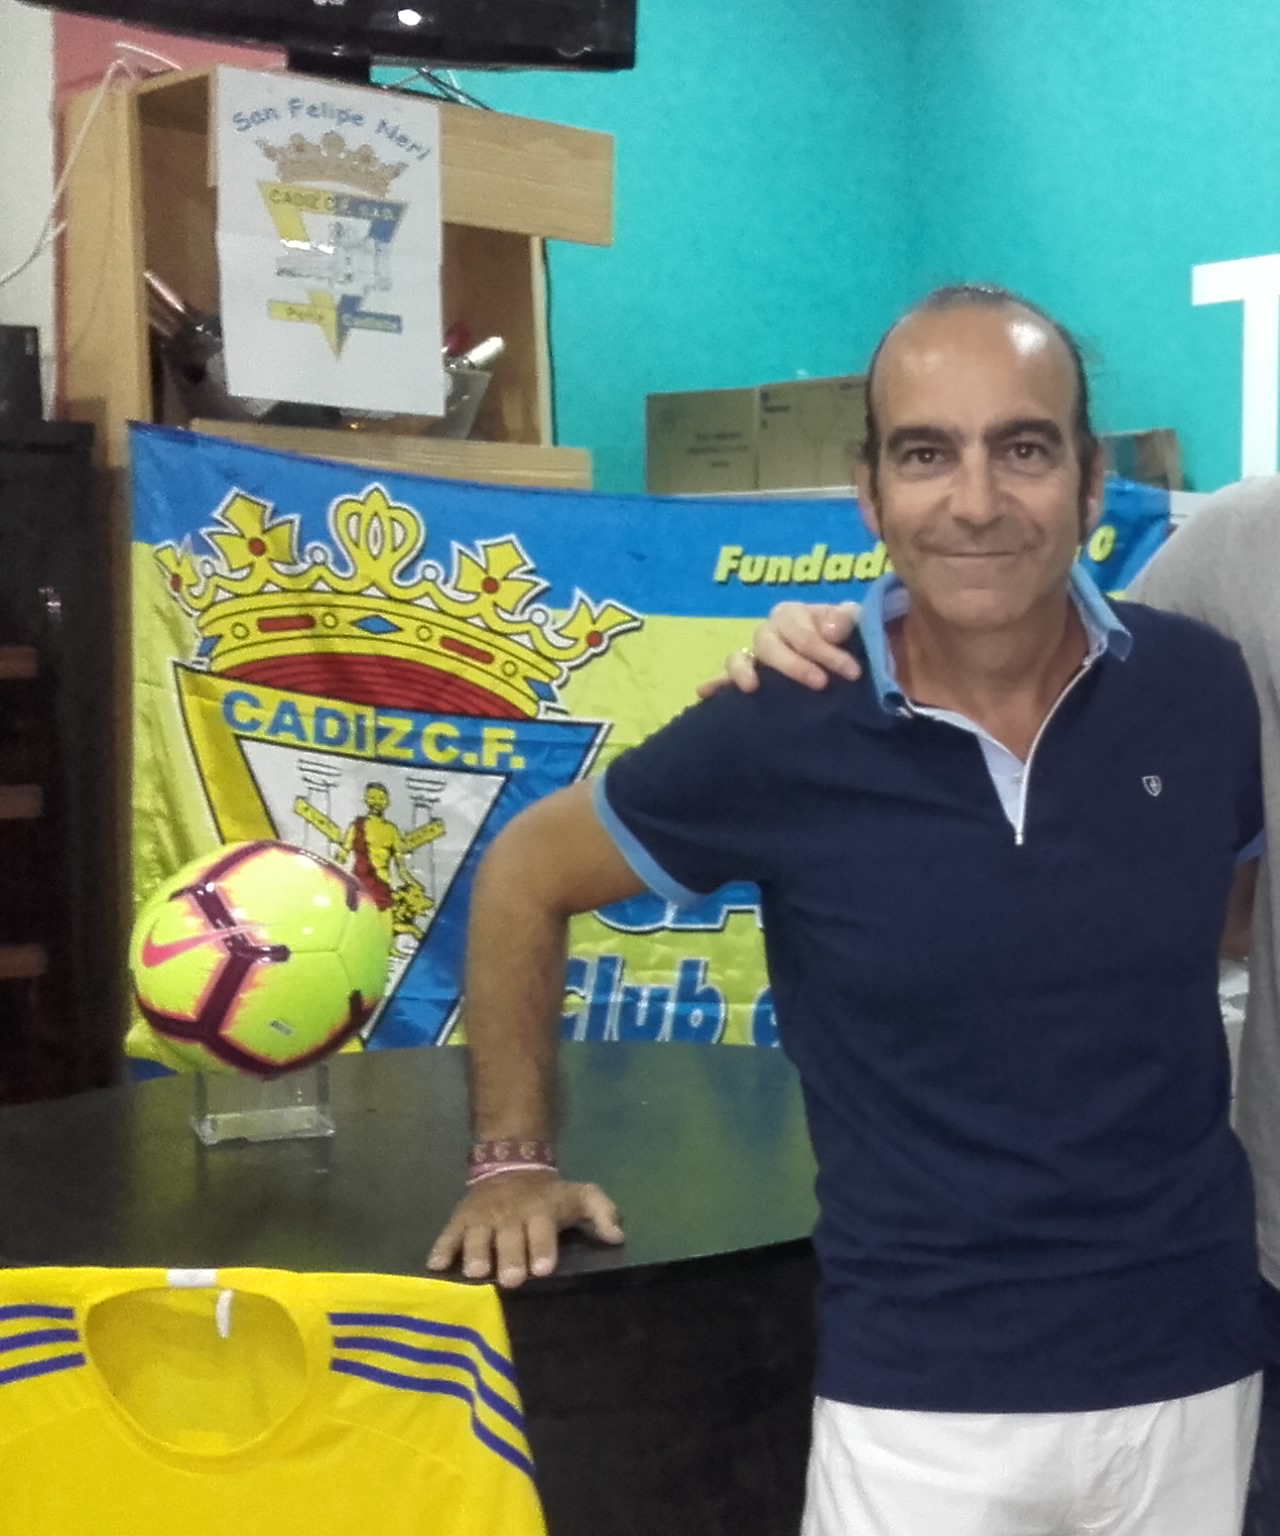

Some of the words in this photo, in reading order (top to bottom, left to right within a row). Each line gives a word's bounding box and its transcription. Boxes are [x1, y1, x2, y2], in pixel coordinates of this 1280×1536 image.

[232, 107, 280, 133] San
[288, 97, 365, 127] Felipe
[375, 118, 431, 160] Neri
